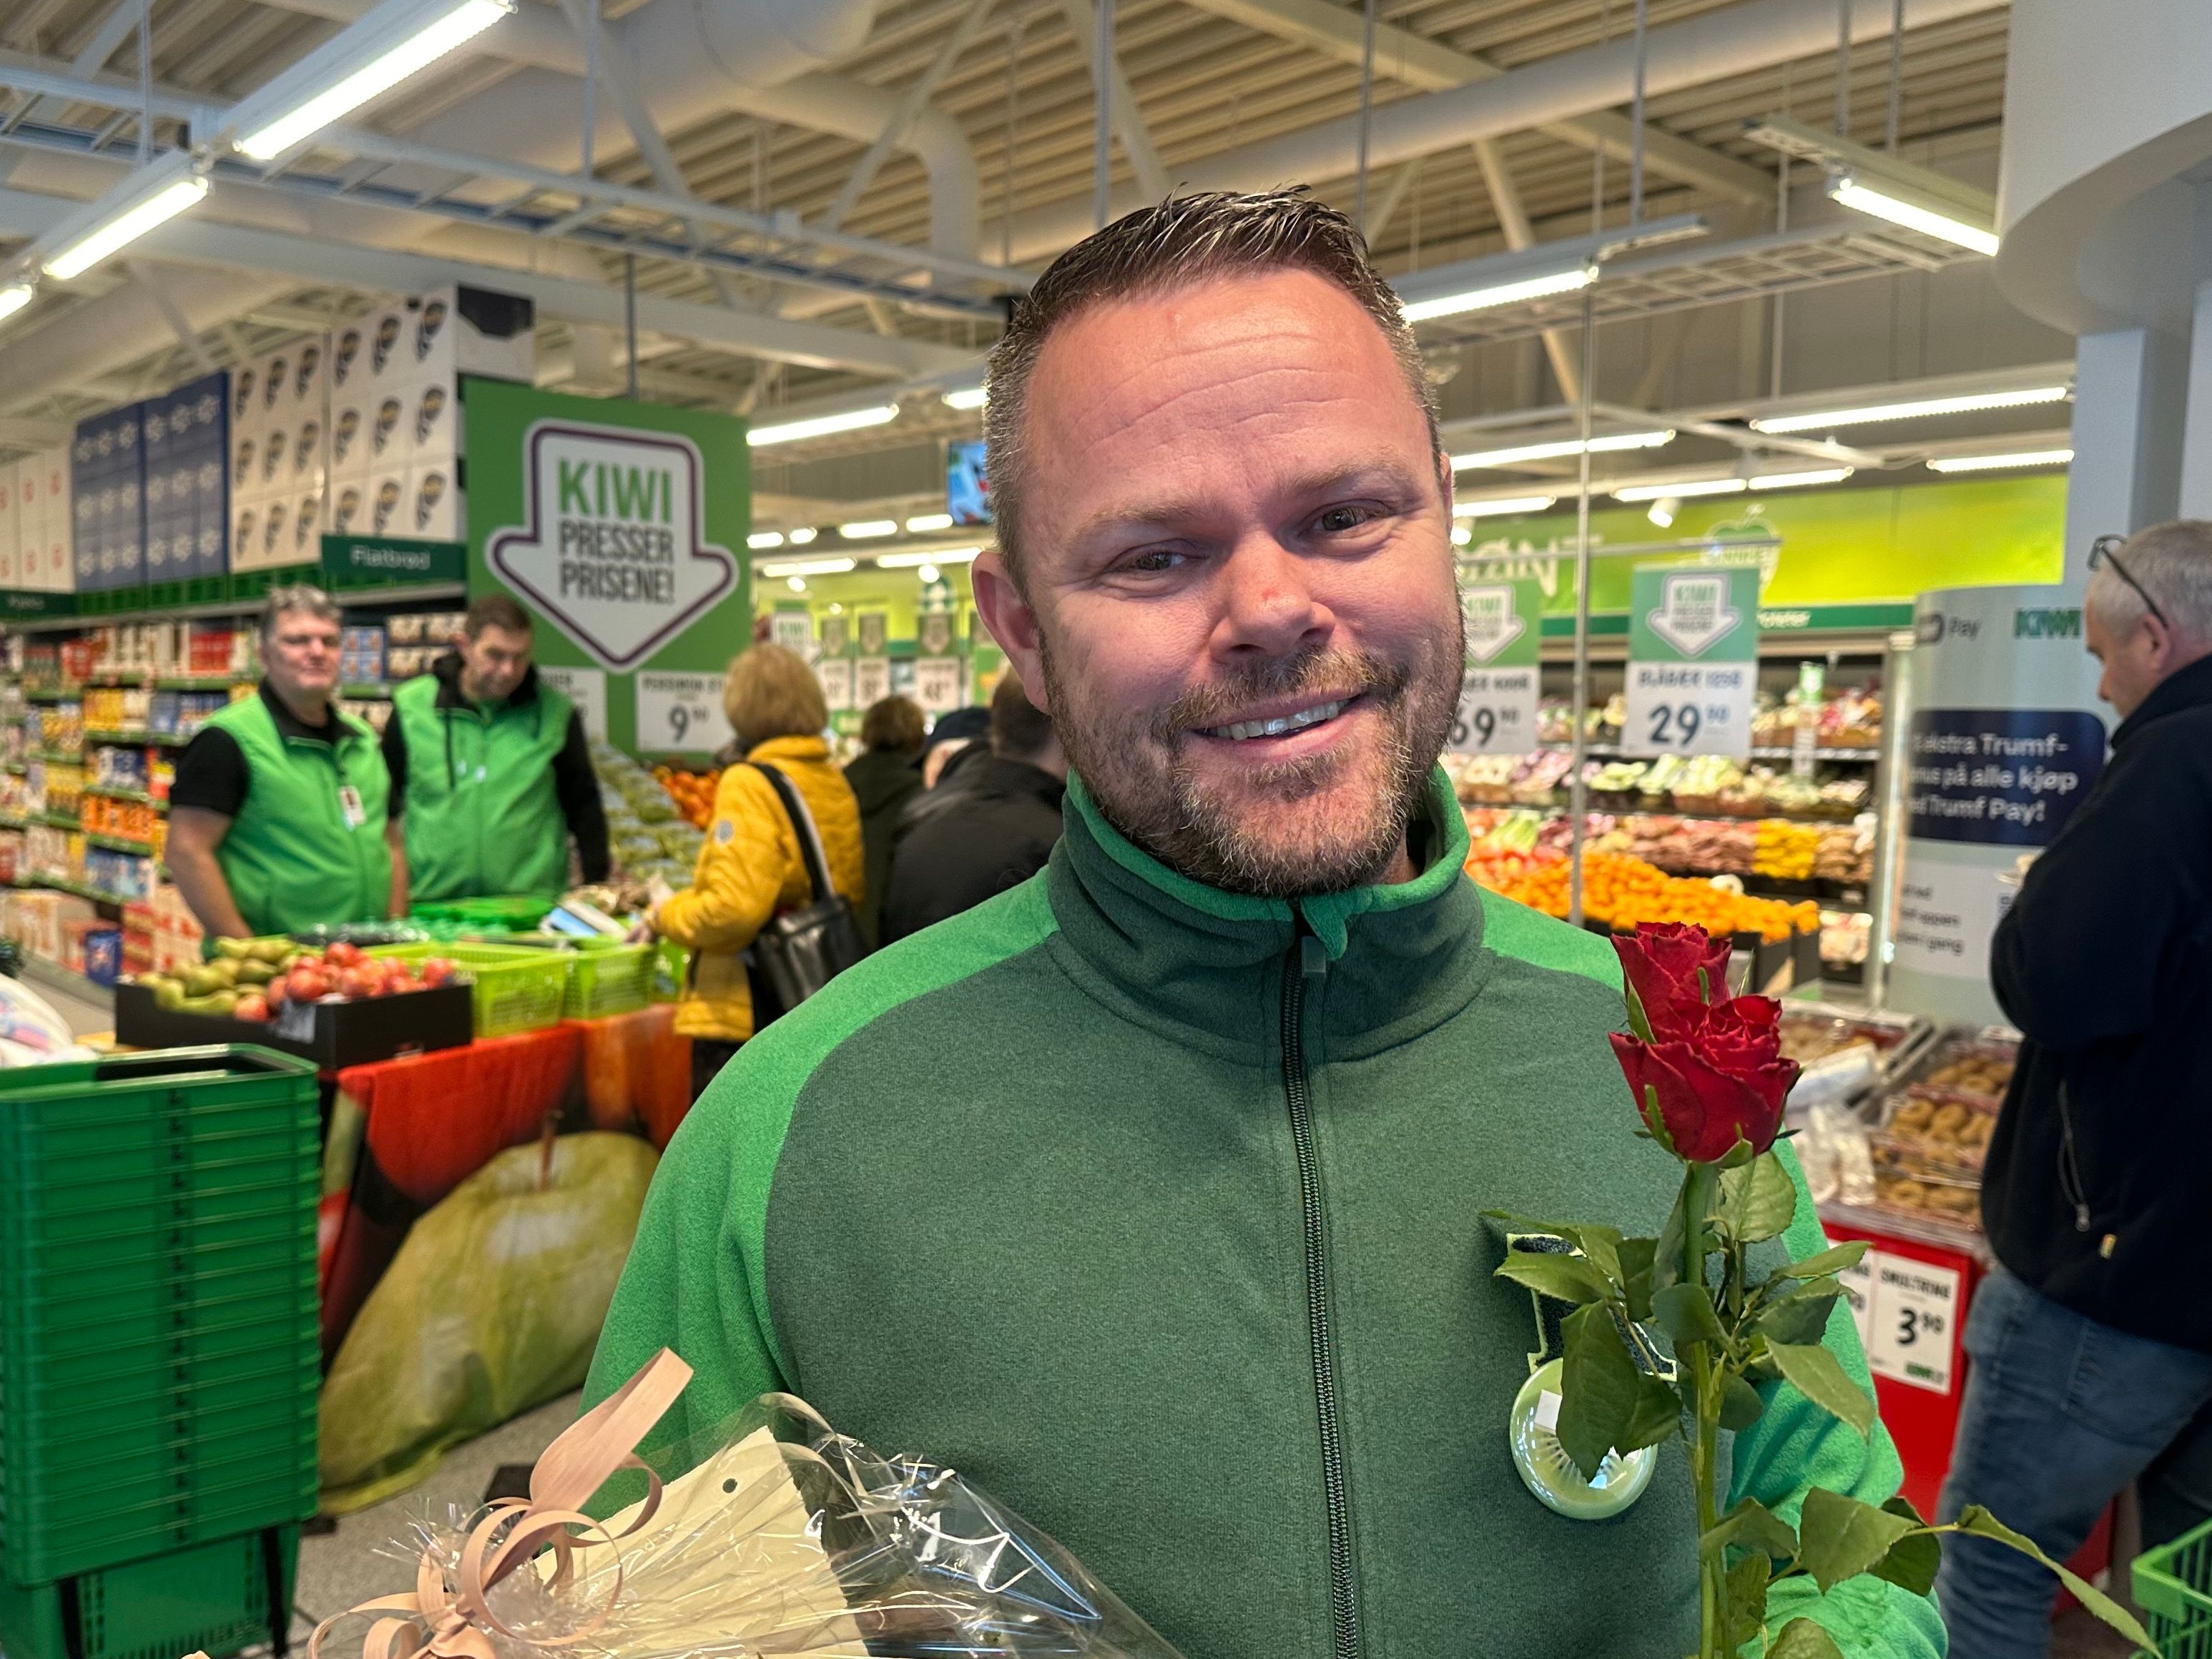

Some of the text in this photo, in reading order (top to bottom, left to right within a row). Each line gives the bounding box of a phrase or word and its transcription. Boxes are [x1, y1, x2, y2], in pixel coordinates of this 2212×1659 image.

[558, 459, 671, 523] KIWI
[351, 545, 431, 569] Flatbrød
[559, 520, 673, 563] PRESSER
[561, 562, 674, 605] PRISENE!
[1947, 617, 1982, 641] Pay
[2015, 609, 2080, 637] KIWI
[669, 702, 690, 744] 9
[1648, 704, 1702, 747] 29
[1979, 732, 2070, 757] Trumf-
[1942, 760, 1969, 791] på
[1971, 763, 2015, 789] alle
[2018, 764, 2080, 795] kjøp
[1928, 794, 1987, 821] Trumf
[1987, 797, 2047, 827] Pay!
[1897, 1306, 1919, 1347] 3
